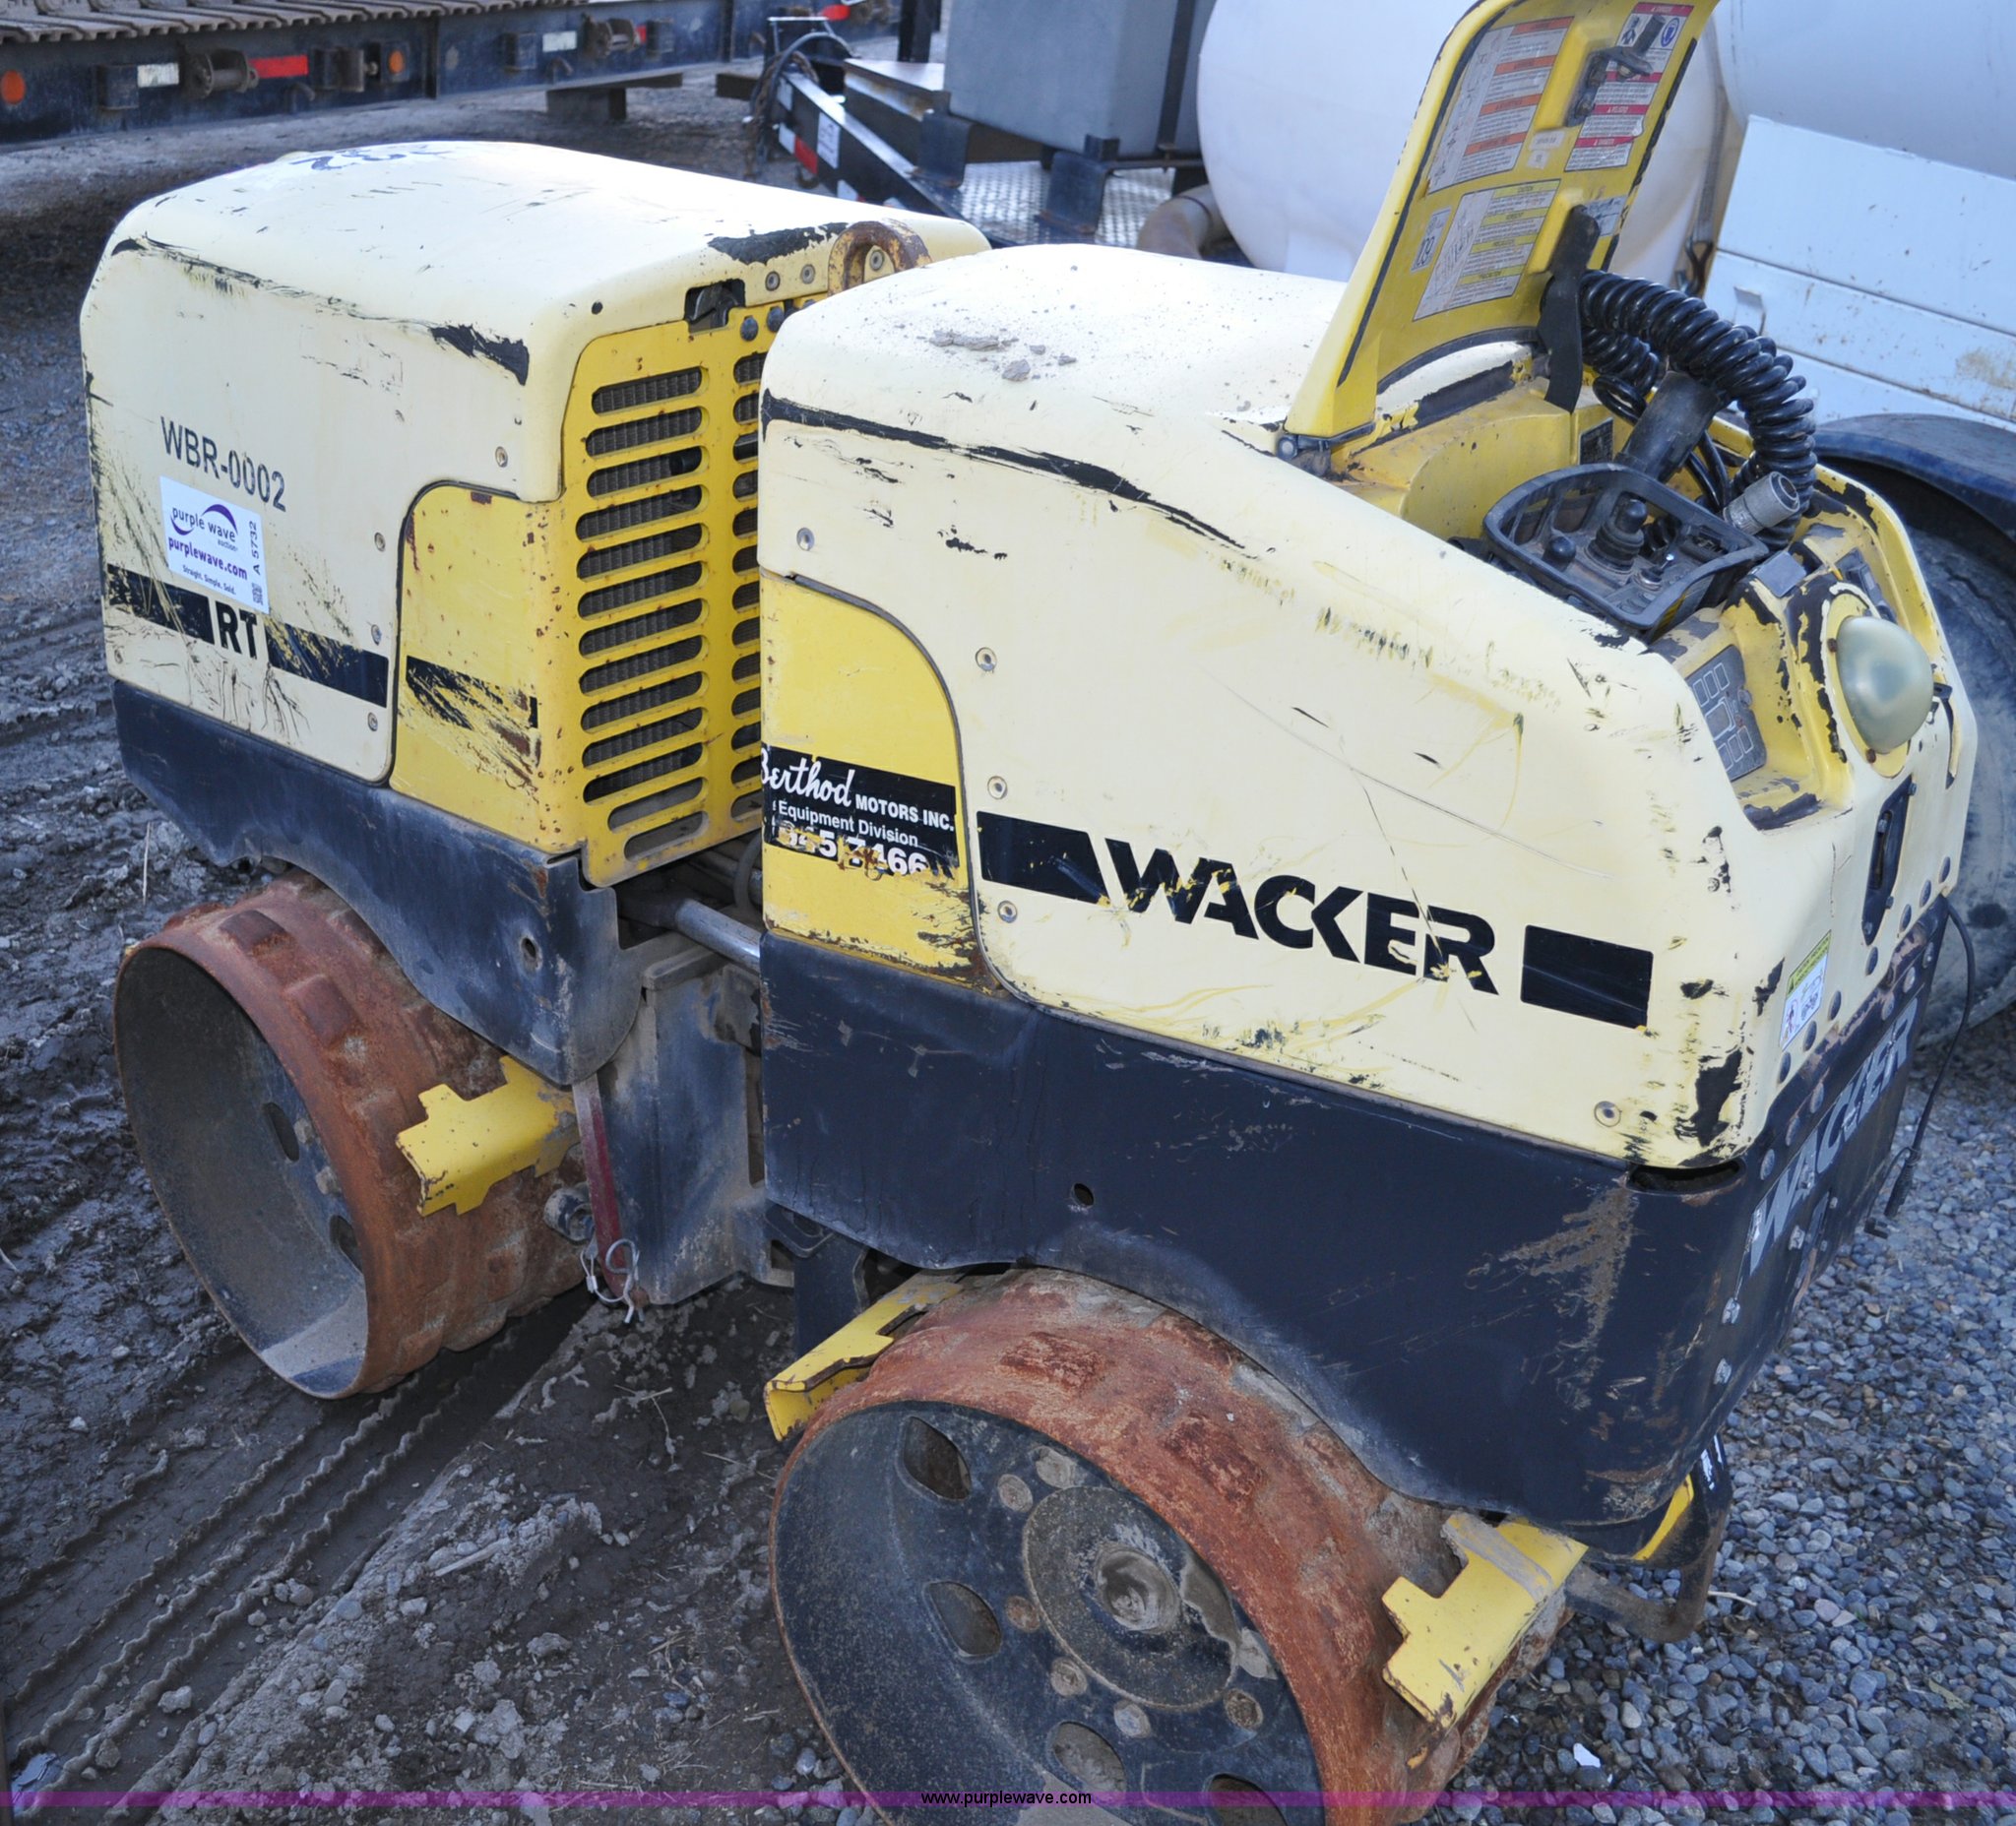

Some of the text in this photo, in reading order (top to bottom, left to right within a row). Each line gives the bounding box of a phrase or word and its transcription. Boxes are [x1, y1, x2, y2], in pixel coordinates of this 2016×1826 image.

[160, 415, 287, 513] WBR-0002
[172, 507, 236, 542] purple wave
[249, 521, 261, 576] A 5732
[168, 536, 248, 581] purplewave.com
[216, 600, 258, 661] RT
[761, 747, 955, 832] Berthod MOTORS INC.
[778, 799, 854, 833] Equipment
[858, 819, 918, 848] Division
[1104, 837, 1499, 996] WACKER
[1749, 997, 1919, 1277] WACKER
